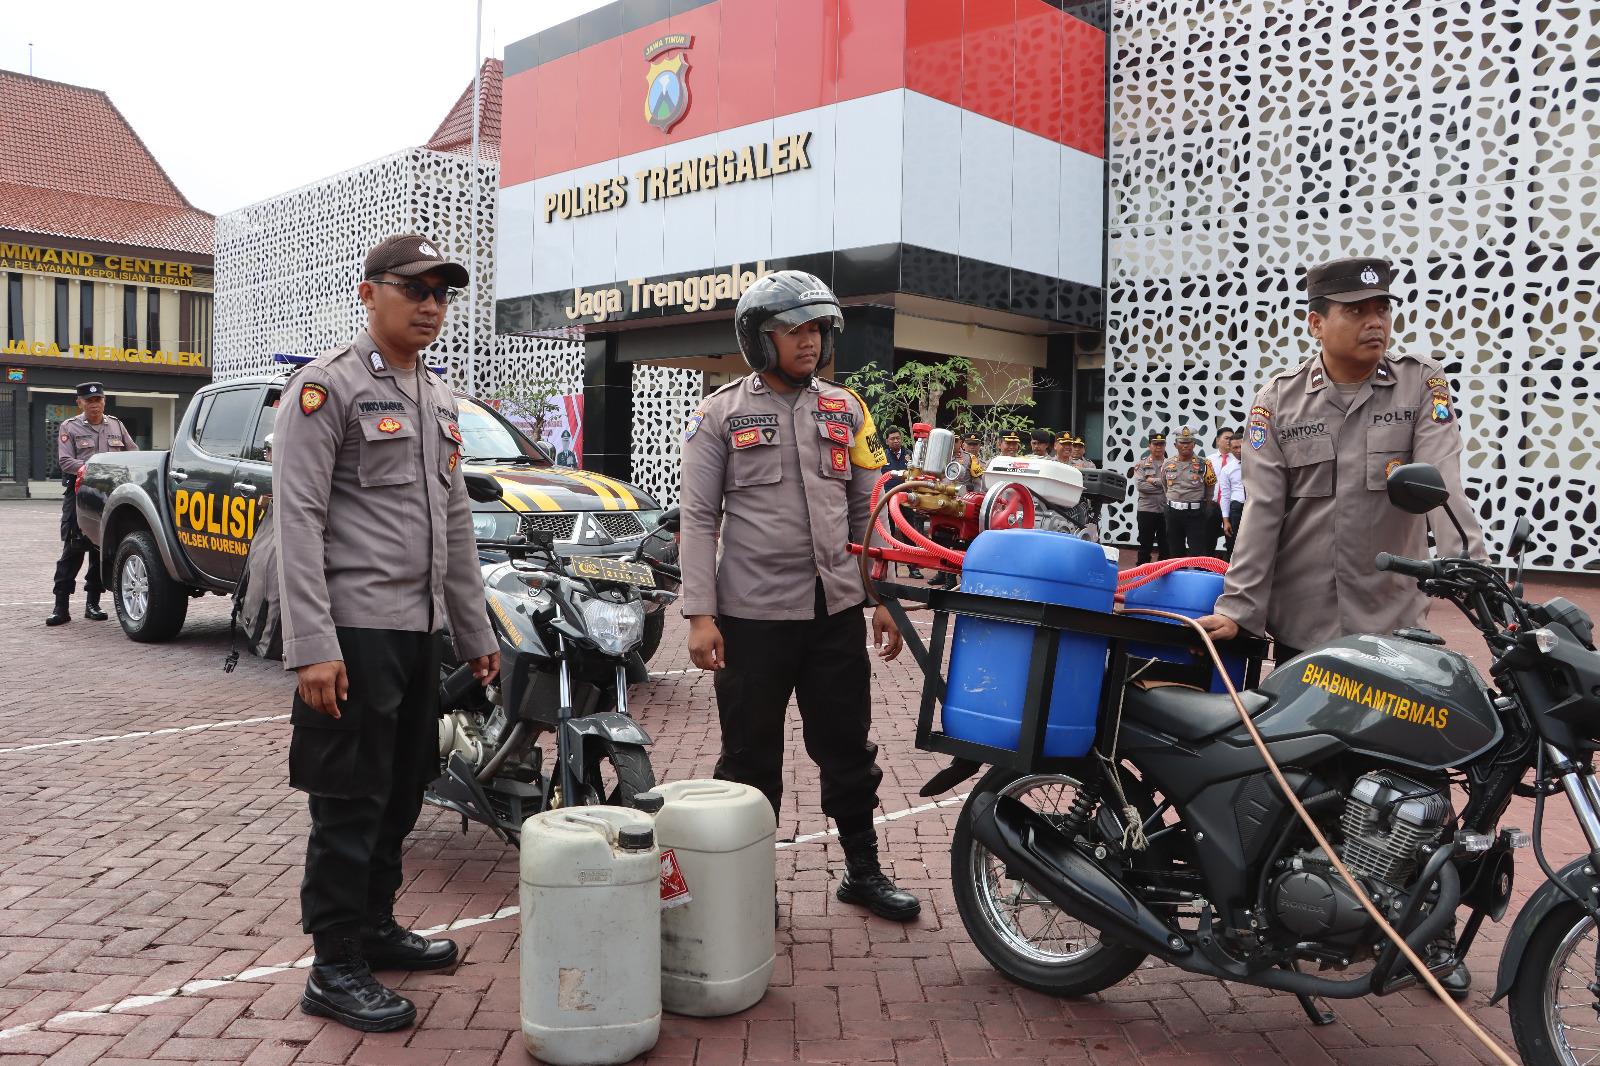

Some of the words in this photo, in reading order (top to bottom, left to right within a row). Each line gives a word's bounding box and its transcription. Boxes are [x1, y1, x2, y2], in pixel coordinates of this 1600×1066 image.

[645, 39, 663, 55] JAWA
[665, 35, 685, 45] TIMUR
[543, 175, 628, 223] POLRES
[635, 132, 812, 203] TRENGGALEK
[0, 243, 94, 267] MMAND
[104, 256, 193, 278] CENTER
[14, 260, 80, 276] PELAYANAN
[84, 268, 146, 282] KEPOLISIAN
[149, 275, 194, 287] TERPADU
[565, 287, 622, 323] Jaga
[3, 339, 61, 358] JAGA
[69, 344, 203, 367] TRENGGALEK
[731, 416, 774, 428] DONNY
[815, 413, 851, 422] POLRI
[1373, 411, 1416, 424] POLRI
[1281, 423, 1325, 440] SANTOSO
[175, 490, 256, 540] POLISI
[177, 531, 209, 549] POLSEK
[210, 536, 250, 556] DURENA
[1359, 653, 1406, 672] HONDA
[1301, 663, 1449, 729] BHABINKAMTIBMAS
[1280, 898, 1327, 915] HONDA
